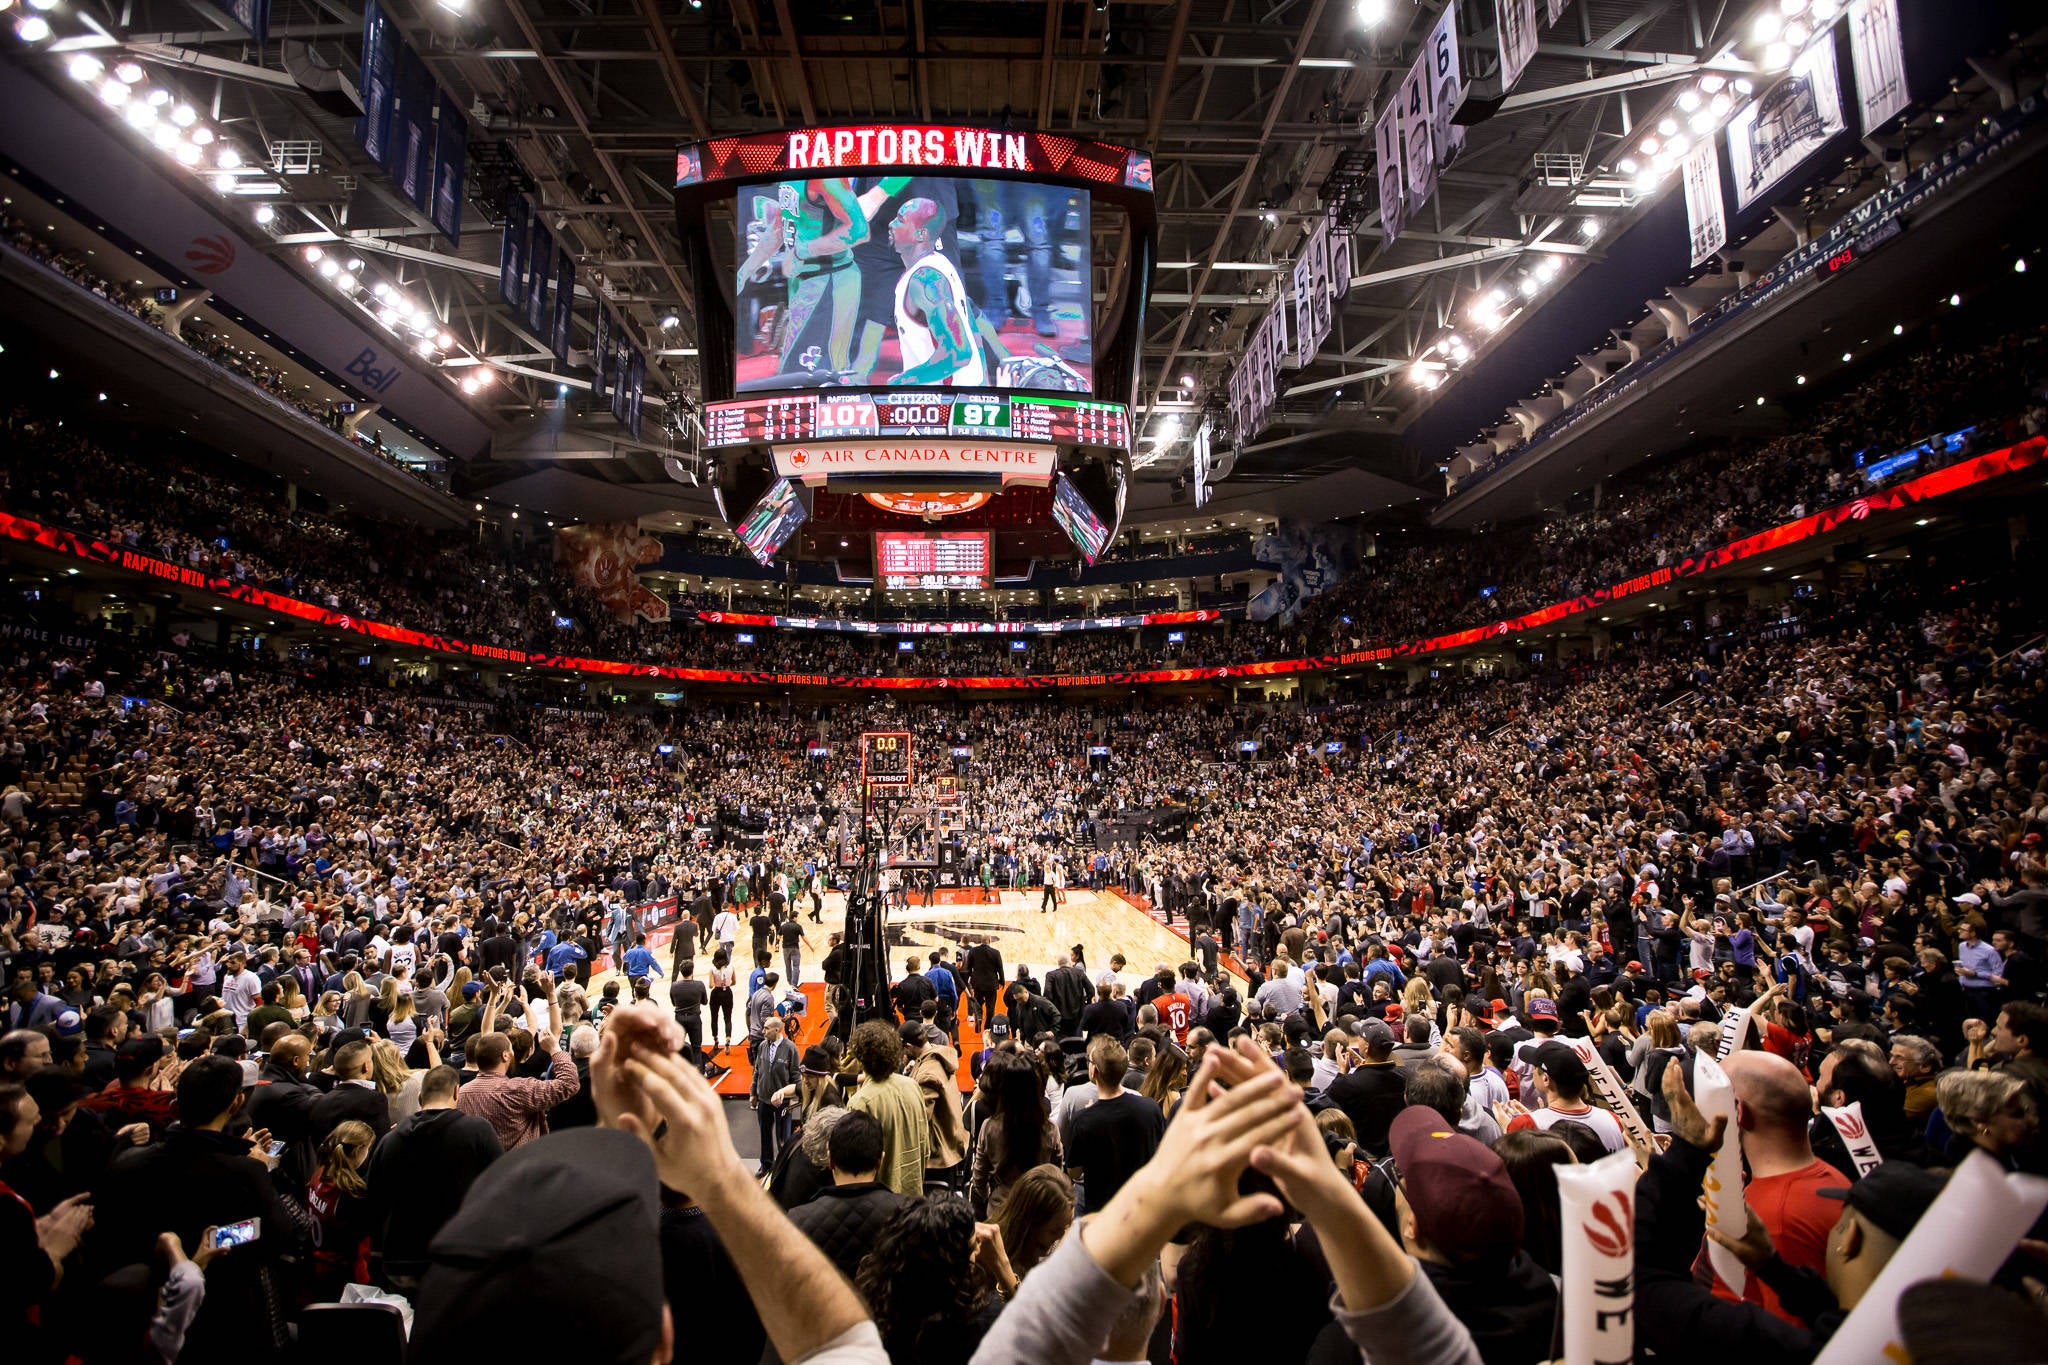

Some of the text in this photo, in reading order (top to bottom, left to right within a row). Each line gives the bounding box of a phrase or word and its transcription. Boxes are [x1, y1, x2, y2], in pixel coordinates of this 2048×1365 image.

[1437, 33, 1450, 78] 6
[1410, 79, 1421, 116] 4
[789, 129, 1026, 170] RAPTORS WIN
[1315, 240, 1322, 269] 4
[1297, 270, 1305, 299] 5
[1275, 310, 1281, 338] 7
[1262, 333, 1268, 360] 9
[344, 347, 402, 393] Bell
[827, 395, 861, 403] RAPTORS
[888, 393, 942, 404] CITIZEN
[968, 395, 1000, 404] CELTICS
[820, 404, 872, 426] 107
[963, 404, 1000, 426] 97
[1029, 424, 1050, 433] Young
[822, 449, 1038, 464] AIR CANADA CENTRE
[123, 551, 205, 588] RAPTORS WIN
[1612, 566, 1672, 600] RAPTORS WIN
[1, 623, 48, 641] MAPLE
[471, 643, 526, 663] RAPTORS WIN
[1340, 646, 1392, 664] RAPTORS WIN
[777, 674, 828, 686] RAPTORS WIN
[1057, 675, 1106, 687] RAPTORS WIN
[877, 737, 897, 750] 0.0
[1170, 1010, 1186, 1030] 10
[1588, 1066, 1608, 1085] WE
[1605, 1090, 1630, 1119] THE
[1851, 1144, 1879, 1174] WE
[1594, 1273, 1634, 1334] WE
